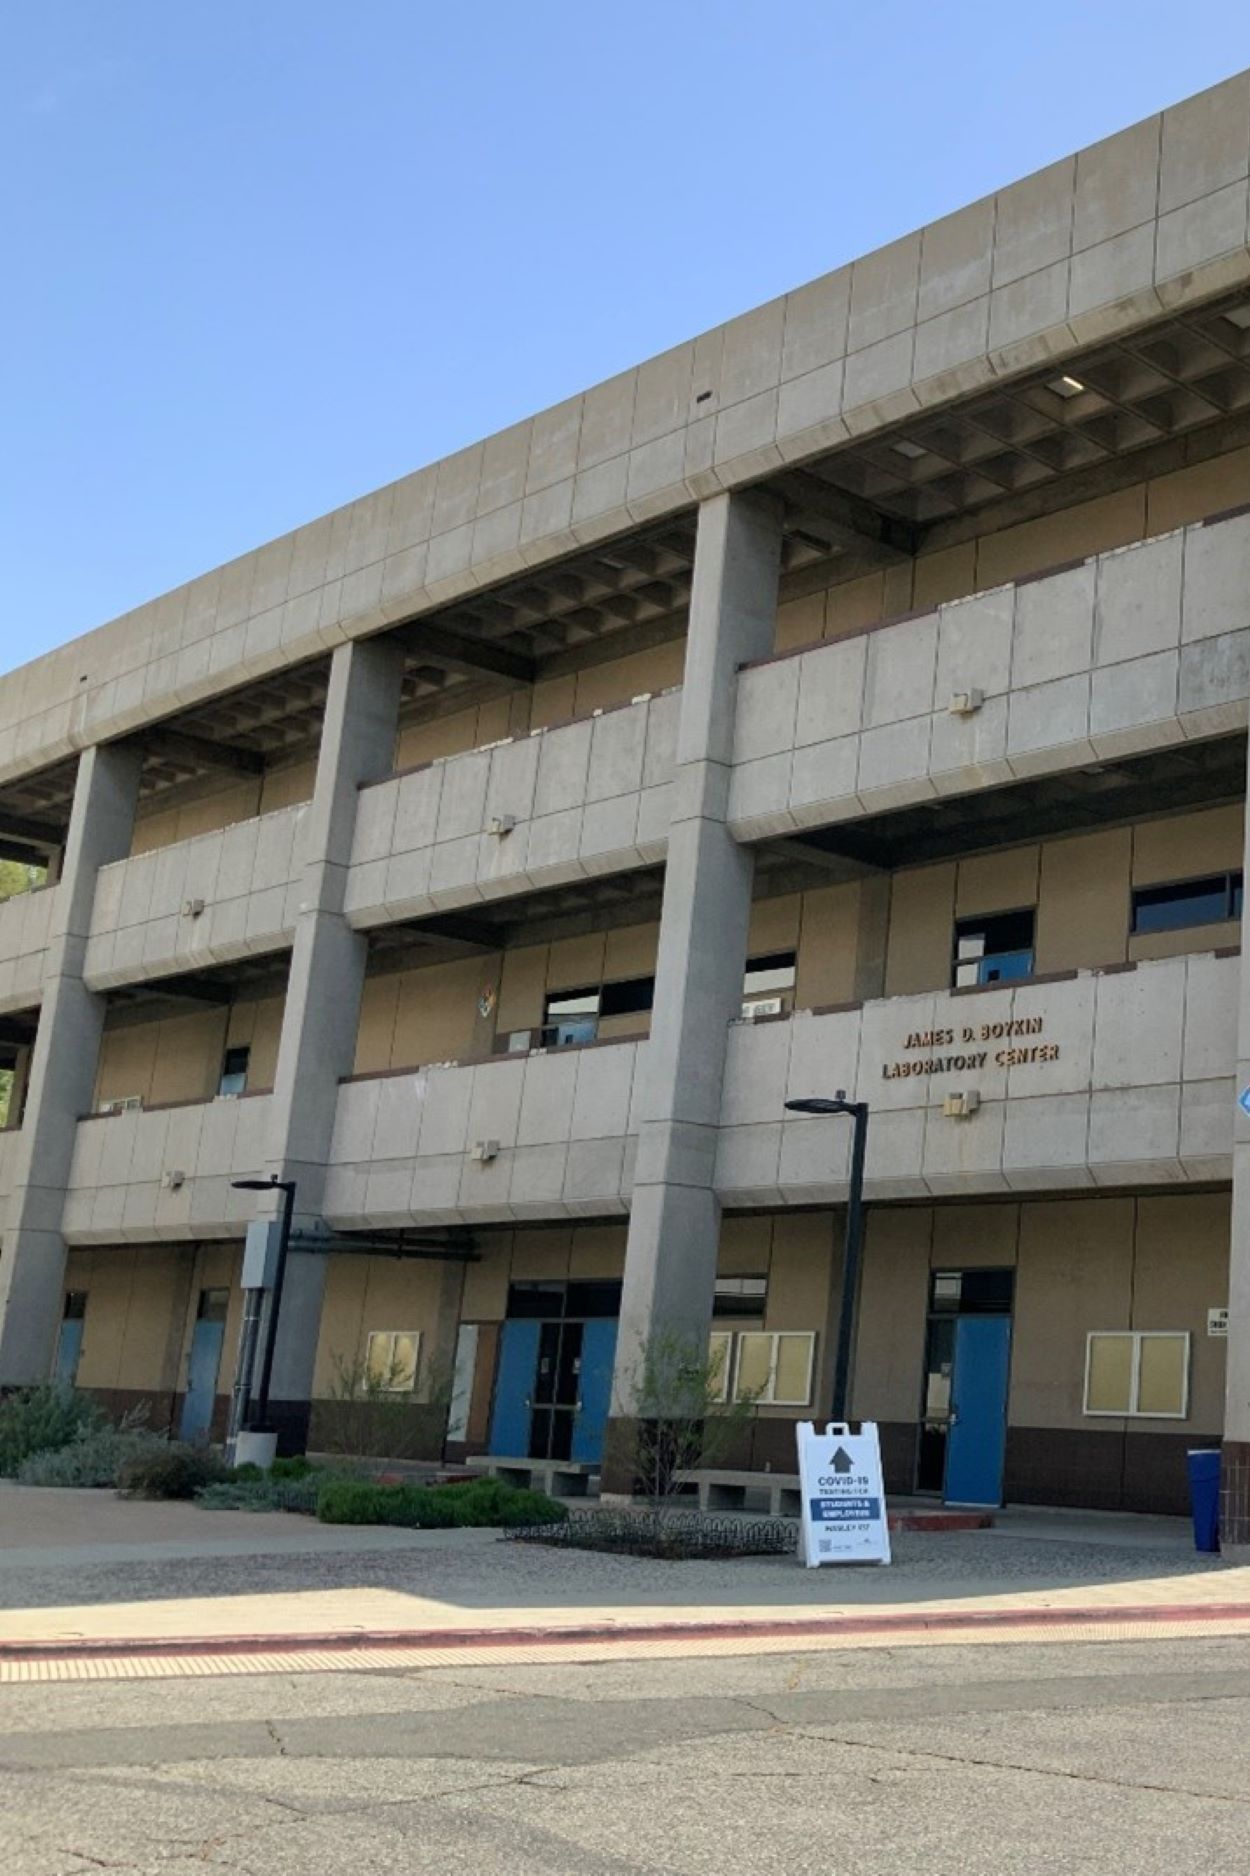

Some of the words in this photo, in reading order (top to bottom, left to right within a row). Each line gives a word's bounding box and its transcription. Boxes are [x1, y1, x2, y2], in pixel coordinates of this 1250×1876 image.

[903, 1028, 953, 1049] JAMES
[962, 1027, 976, 1043] D.
[981, 1016, 1043, 1041] BOYKIN
[882, 1052, 987, 1080] LABORATORY
[995, 1044, 1060, 1067] CENTER
[817, 1476, 869, 1487] COVID-19
